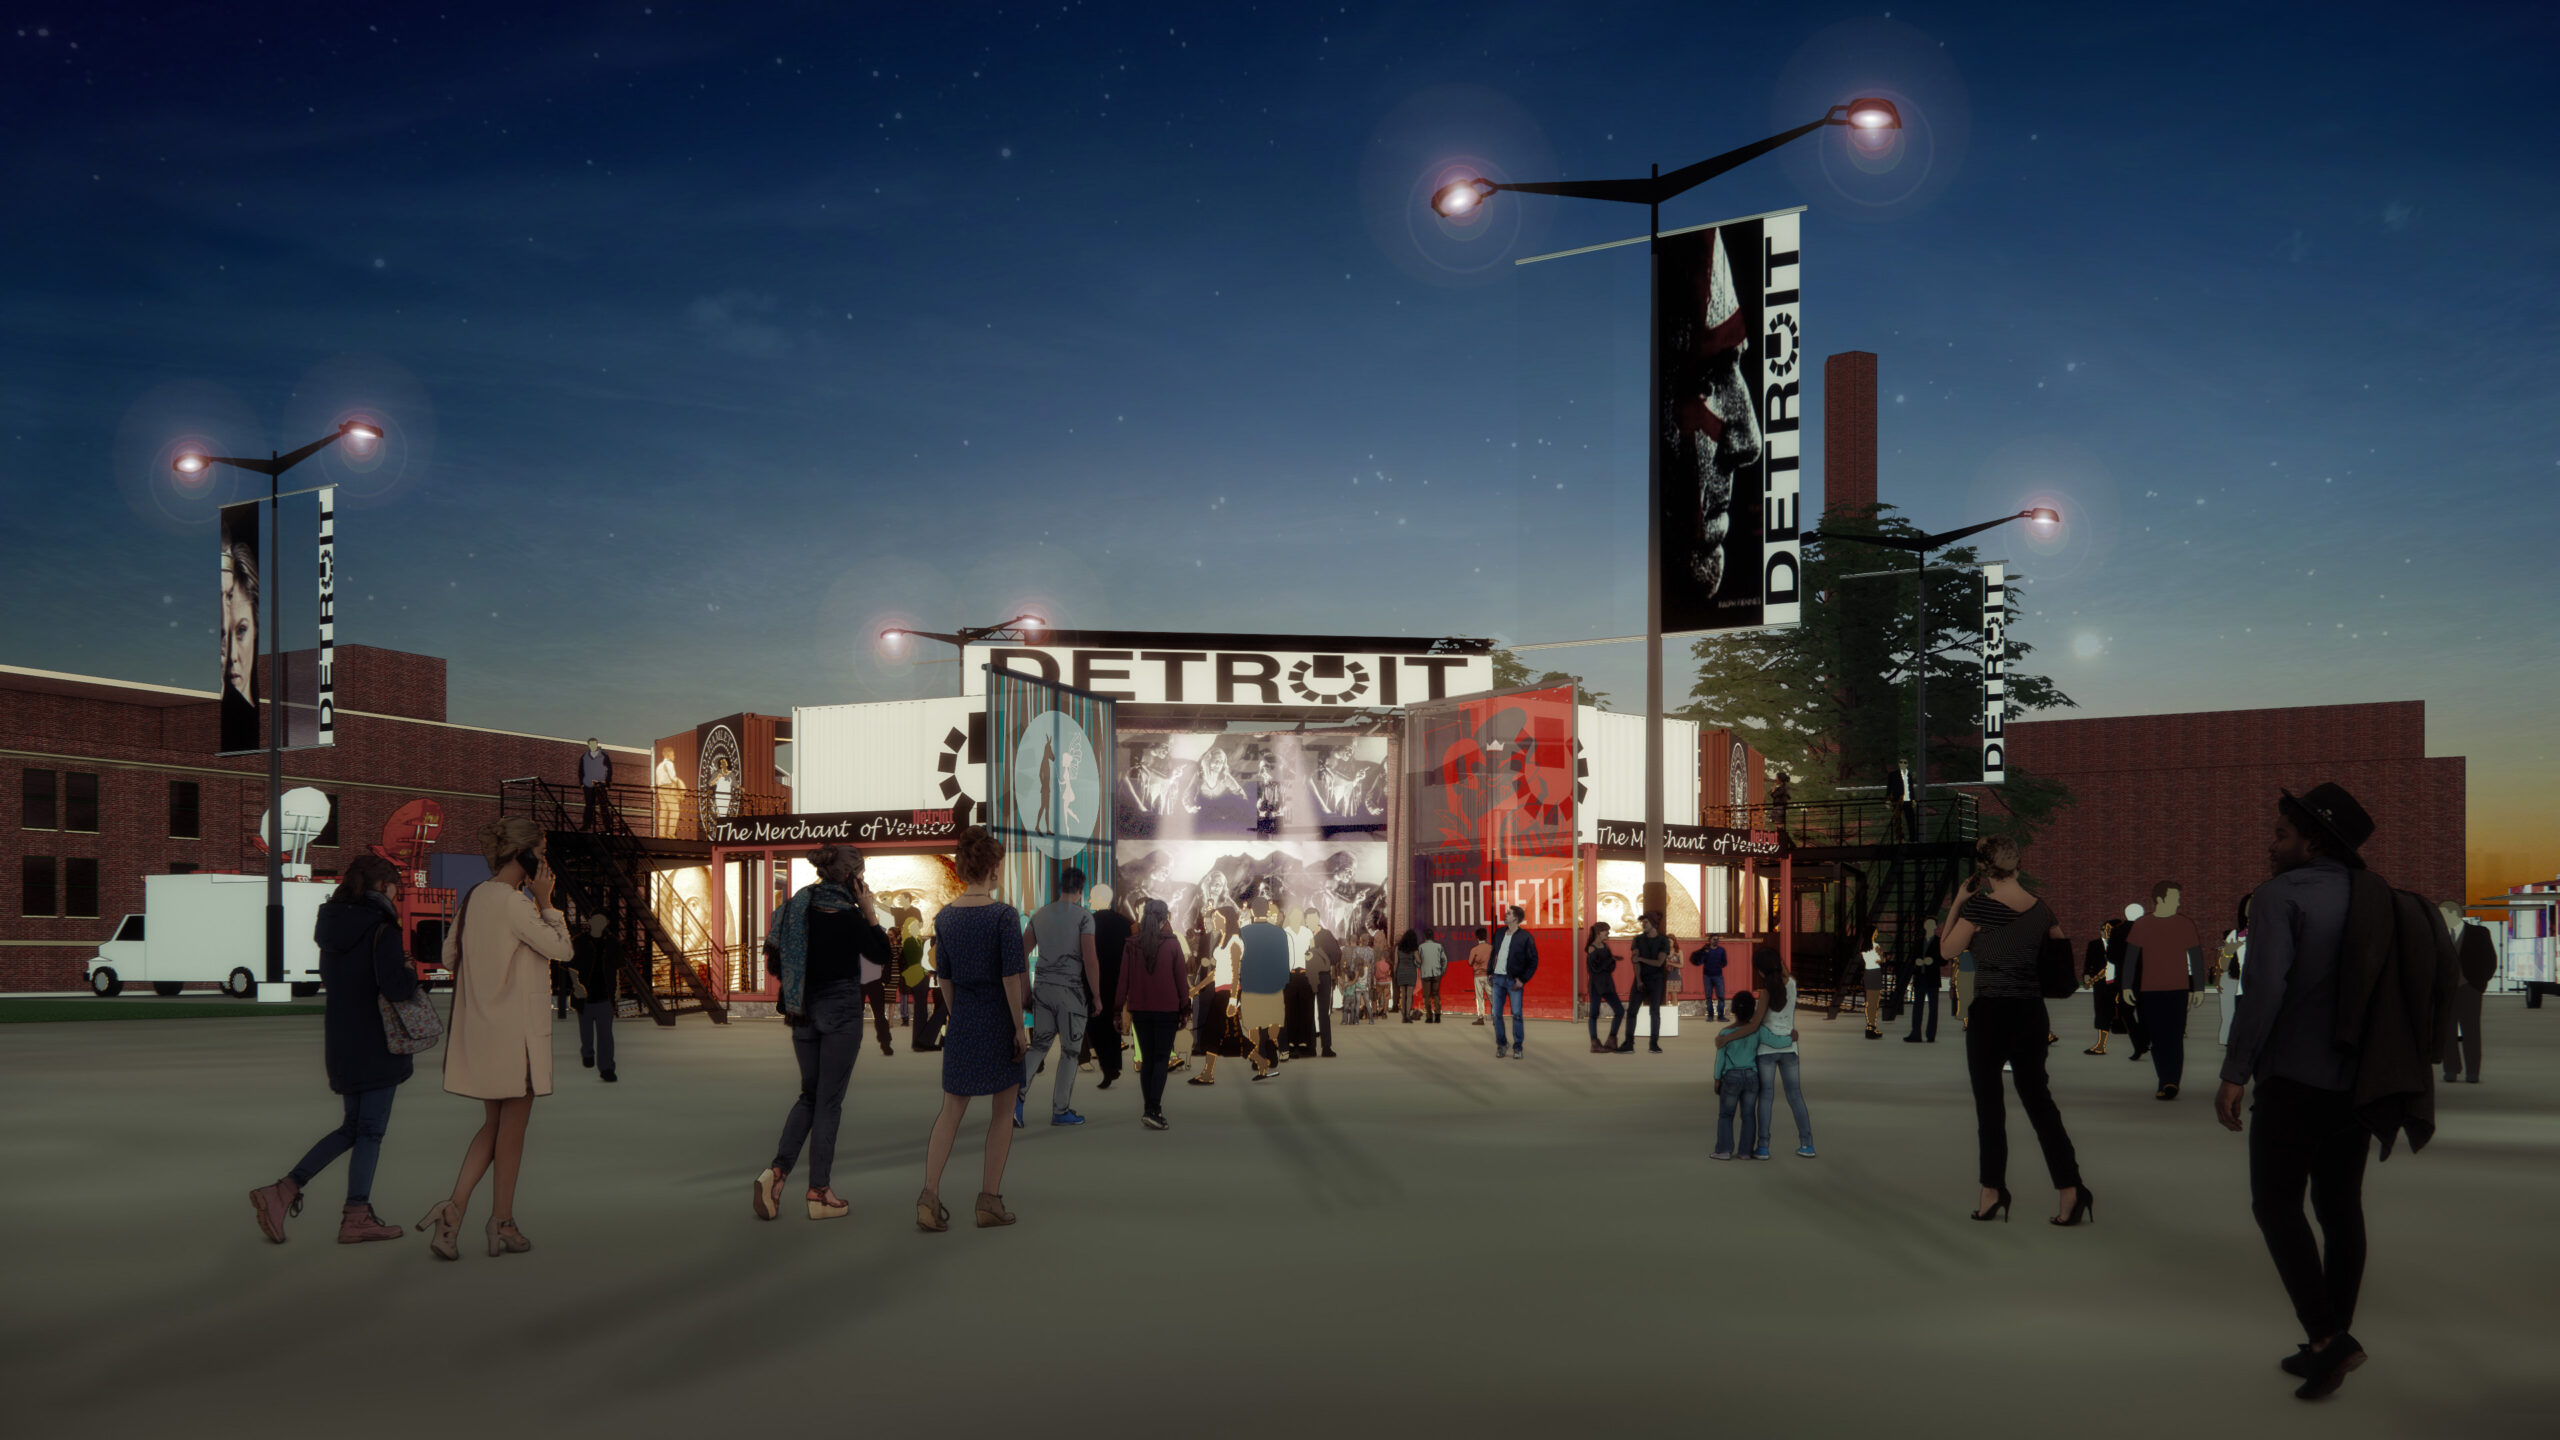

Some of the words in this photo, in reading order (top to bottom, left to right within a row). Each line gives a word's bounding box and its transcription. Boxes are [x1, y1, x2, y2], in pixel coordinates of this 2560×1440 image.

[1765, 236, 1800, 606] DETROIT
[319, 501, 334, 732] DETROIT
[1984, 576, 2004, 773] DETROIT
[716, 822, 752, 842] The
[754, 819, 852, 841] Merchant
[860, 816, 883, 841] of
[1598, 826, 1629, 847] The
[1631, 828, 1708, 851] Mhant
[1713, 832, 1730, 855] of
[1432, 878, 1564, 927] MACBETH
